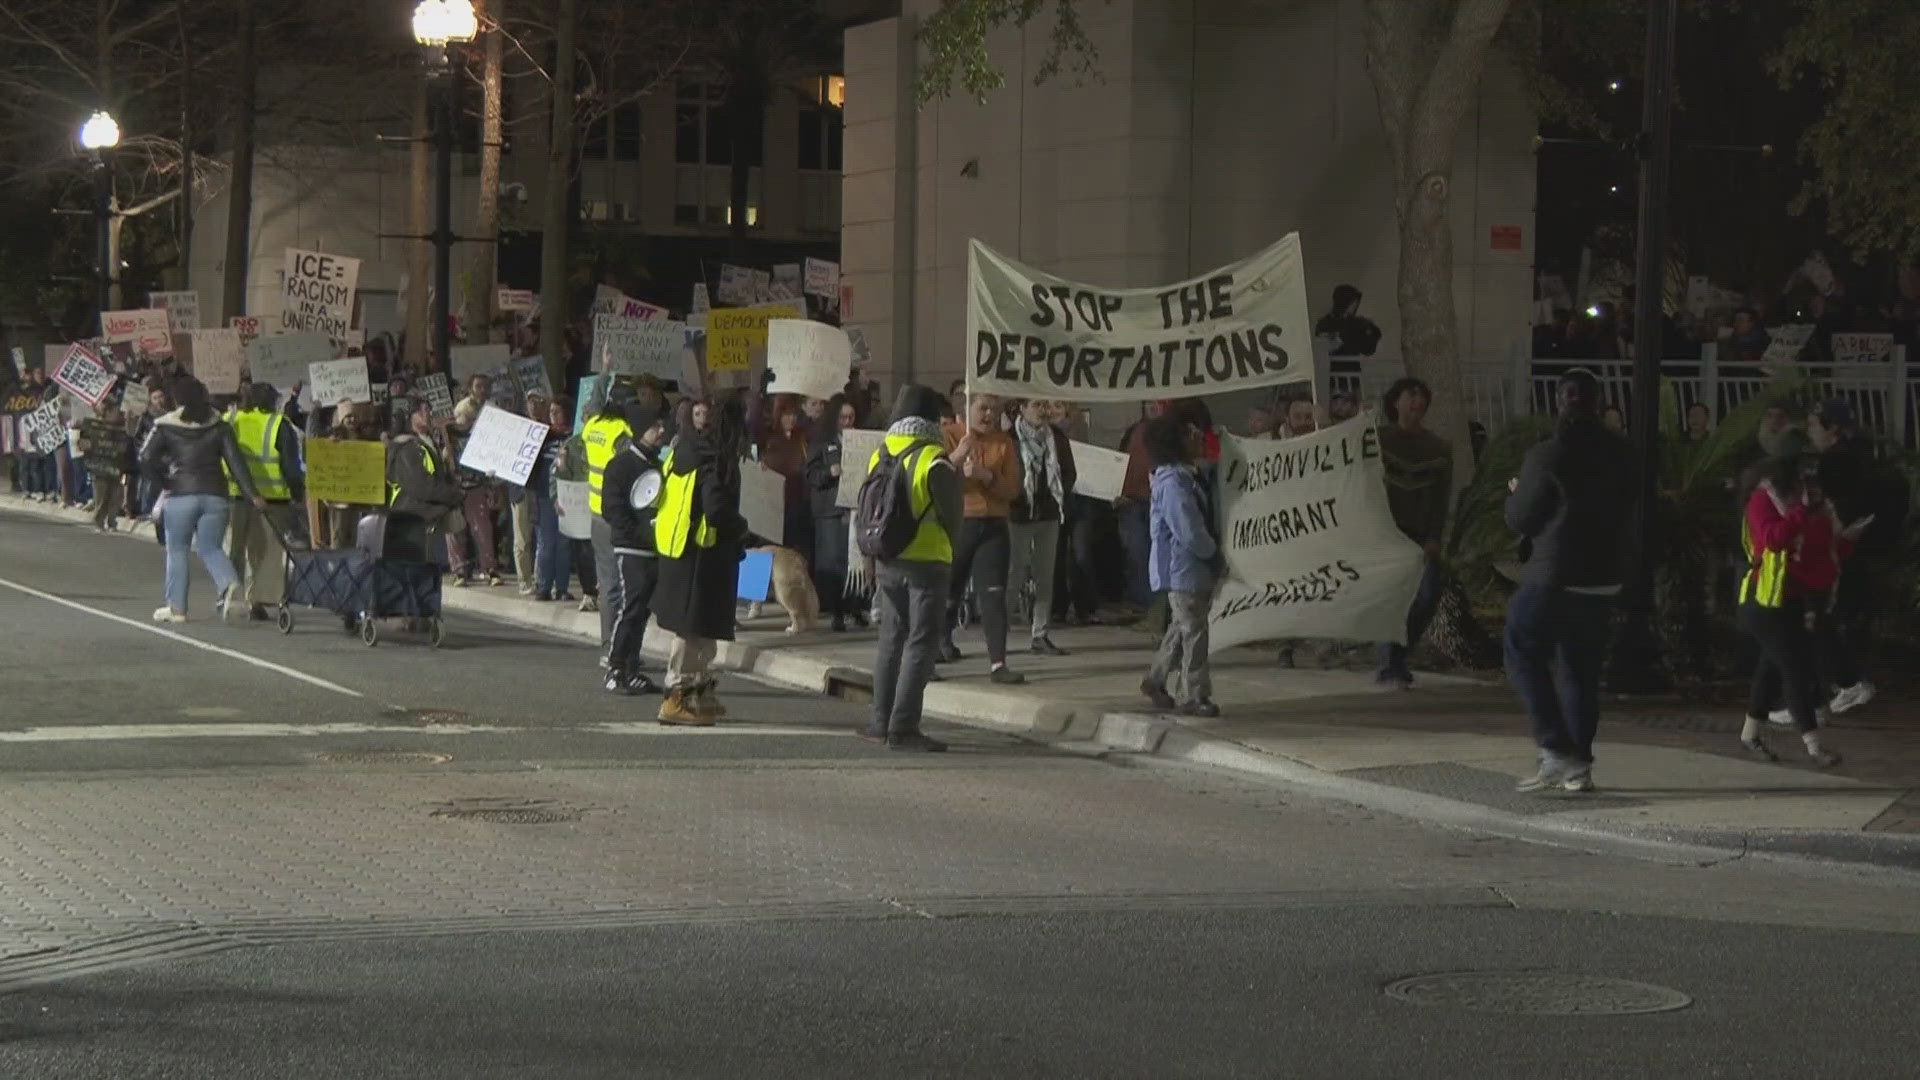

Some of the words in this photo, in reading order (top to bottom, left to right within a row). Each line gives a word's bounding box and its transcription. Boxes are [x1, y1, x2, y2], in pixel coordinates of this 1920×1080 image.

[295, 254, 334, 281] ICE
[288, 277, 348, 306] RACISM
[300, 301, 315, 314] IN
[317, 305, 327, 316] A
[624, 301, 658, 319] NOT
[1030, 283, 1122, 331] STOP
[1157, 274, 1234, 329] THE
[233, 318, 258, 328] NO
[283, 310, 346, 336] UNIFORM
[616, 334, 670, 348] TYRANNY
[975, 324, 1289, 389] DEPORTATIONS
[526, 424, 547, 442] ICE
[518, 441, 538, 460] ICE
[512, 460, 531, 477] ICE
[1232, 498, 1339, 550] IMMIGRANT
